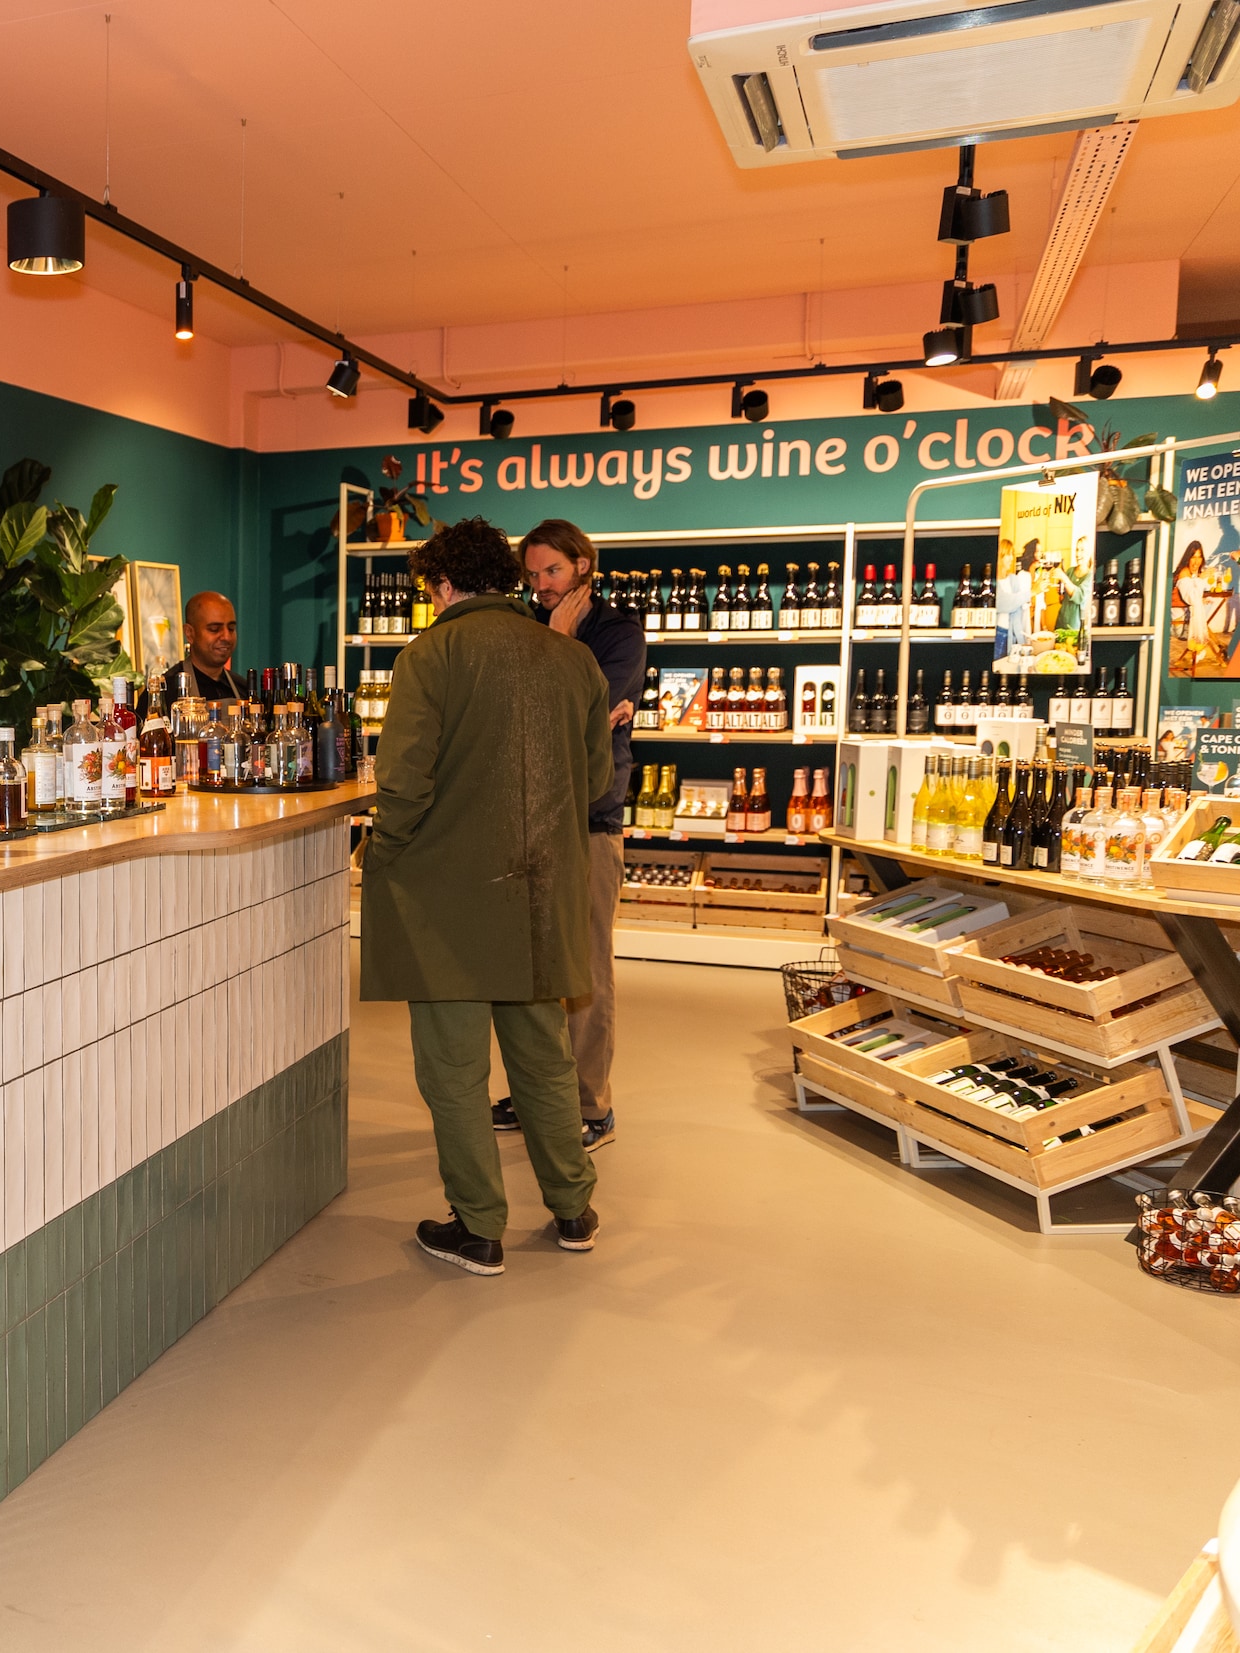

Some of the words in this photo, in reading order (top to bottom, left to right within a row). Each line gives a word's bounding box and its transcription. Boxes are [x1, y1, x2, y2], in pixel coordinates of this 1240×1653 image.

[415, 447, 486, 495] It's
[496, 443, 693, 501] always
[707, 427, 848, 482] wine
[863, 417, 1097, 472] o'clock
[1186, 467, 1209, 484] WE
[1184, 484, 1215, 503] MET
[1017, 506, 1041, 519] world
[1042, 504, 1053, 518] of
[1054, 492, 1077, 515] NIX
[1200, 733, 1233, 744] CAPE
[1200, 744, 1210, 754] &
